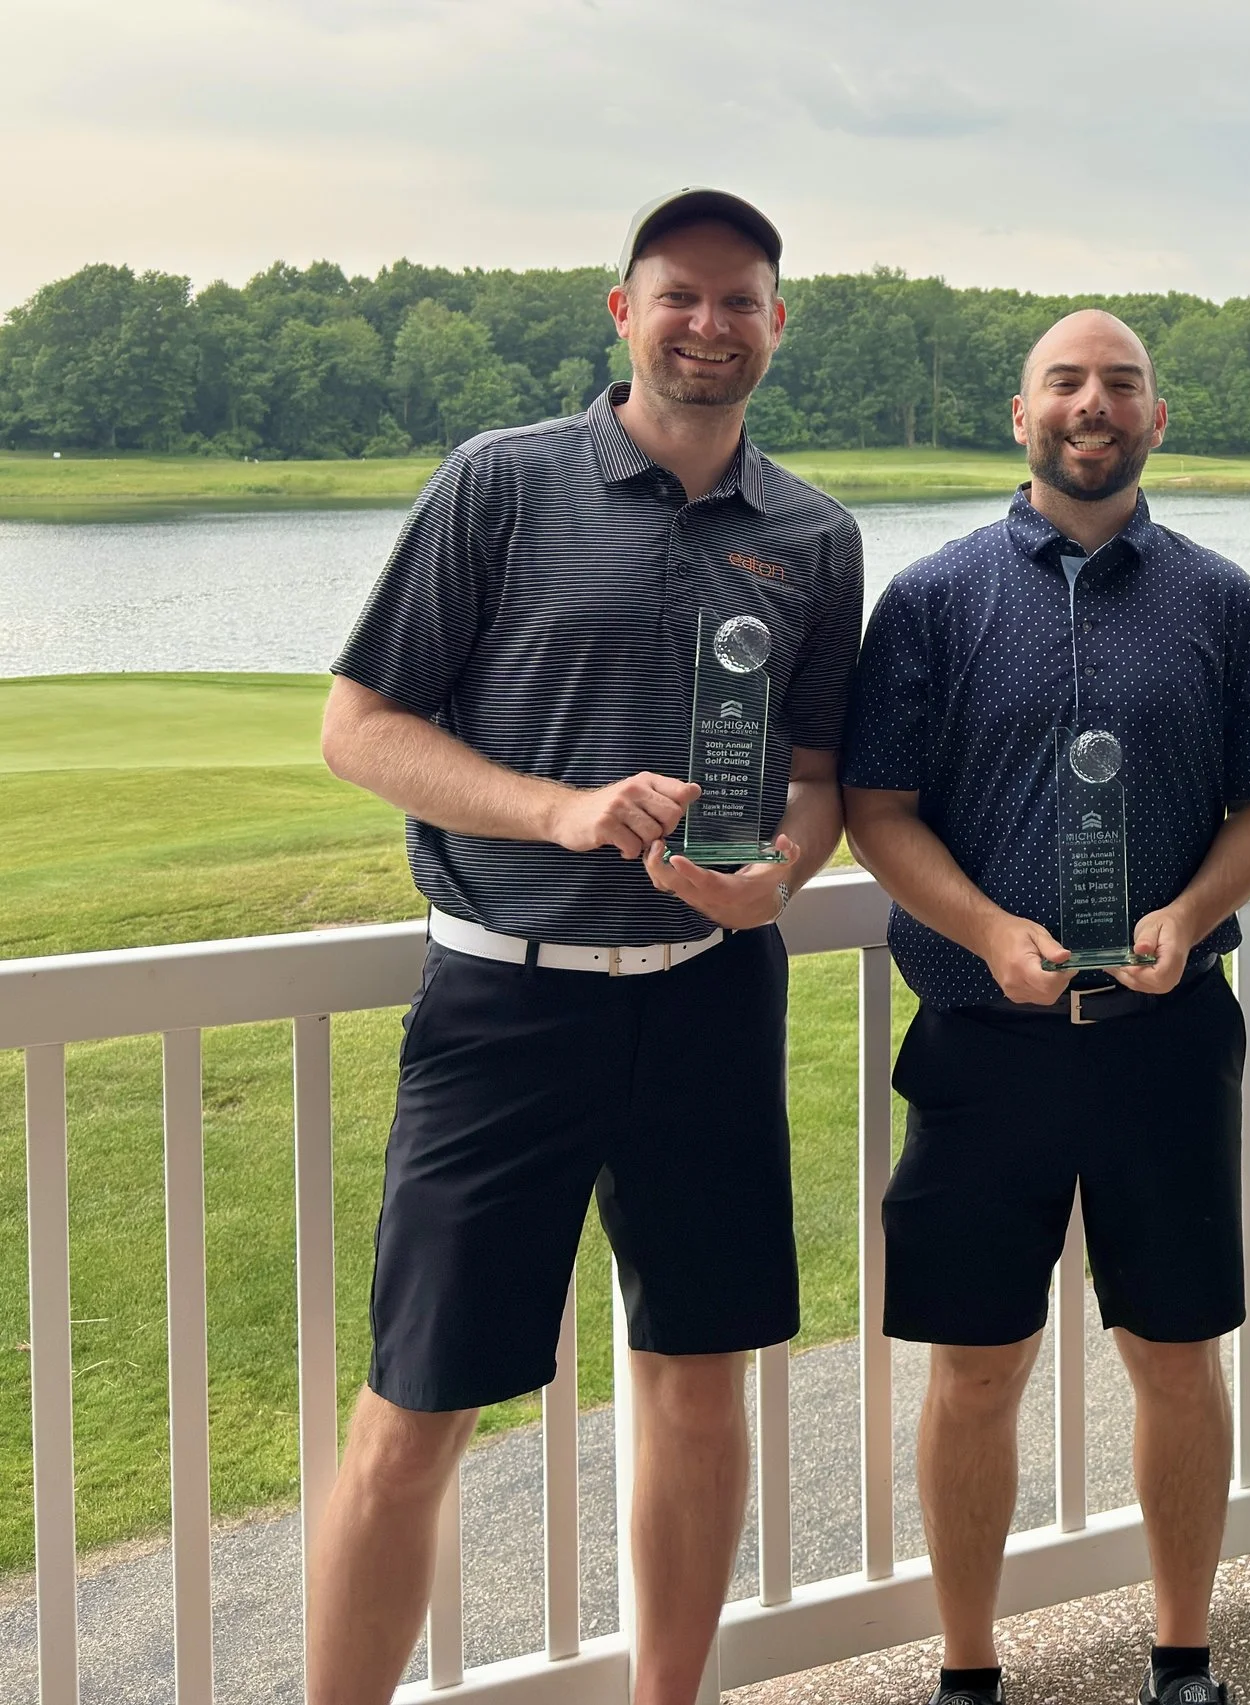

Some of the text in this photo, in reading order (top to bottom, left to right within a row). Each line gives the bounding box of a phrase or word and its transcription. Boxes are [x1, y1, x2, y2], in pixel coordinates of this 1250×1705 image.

[701, 720, 759, 730] MICHIGAN
[705, 741, 753, 749] 30th Annual
[729, 750, 751, 758] Larry
[705, 757, 750, 766] Golf Outing
[705, 773, 749, 782] 1st Place
[1065, 830, 1119, 841] MICHIGAN
[1090, 851, 1115, 859] Annual
[1073, 860, 1093, 868] Scott
[1073, 881, 1115, 891] 1st Place
[1183, 1688, 1208, 1703] DUDE
